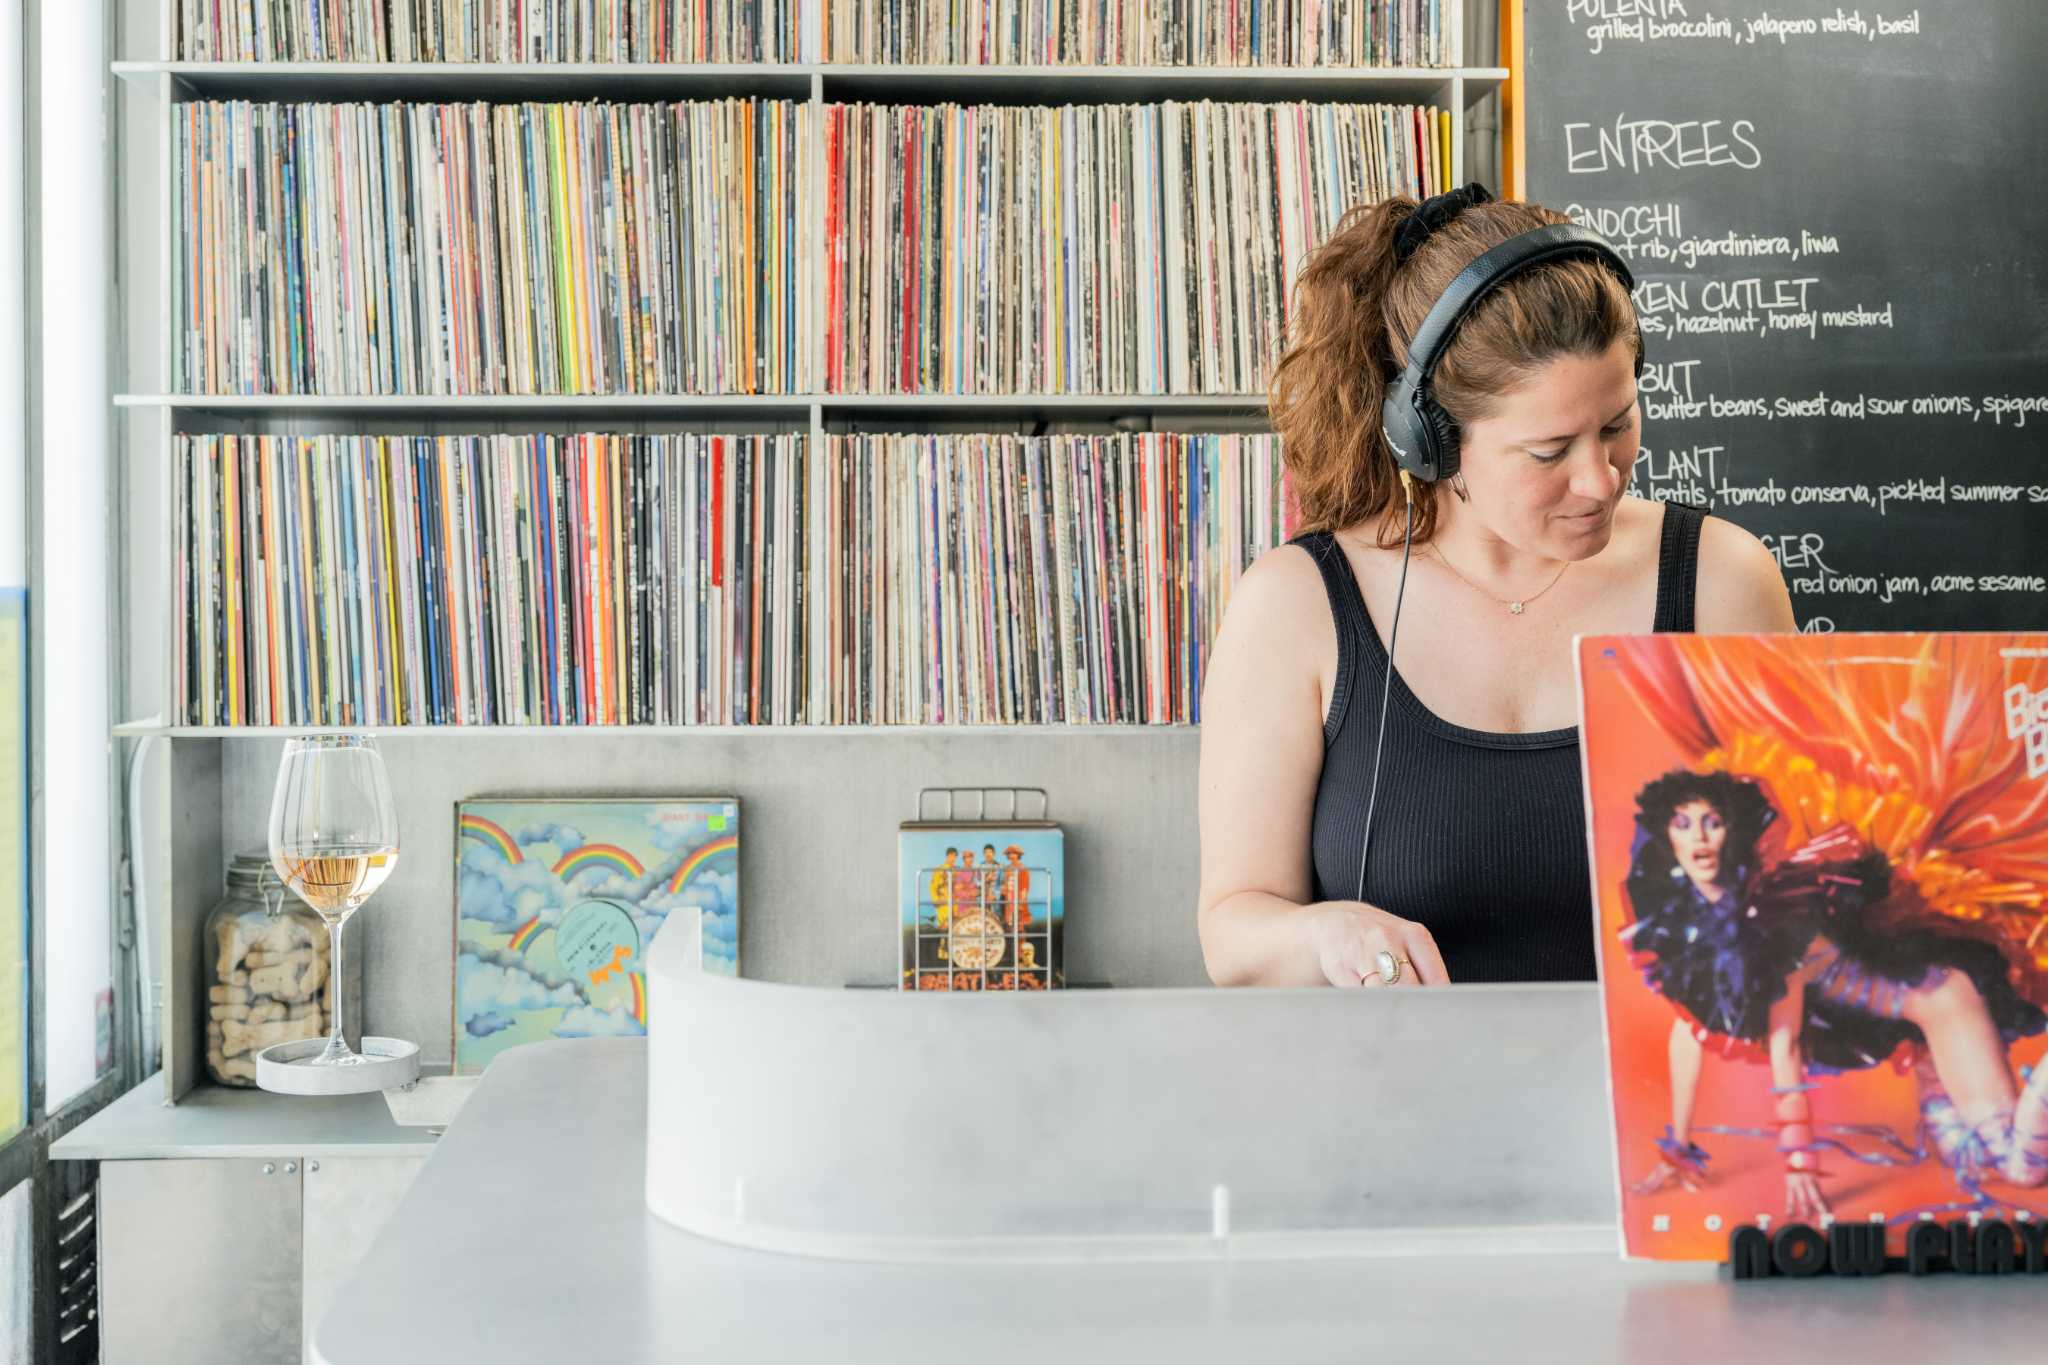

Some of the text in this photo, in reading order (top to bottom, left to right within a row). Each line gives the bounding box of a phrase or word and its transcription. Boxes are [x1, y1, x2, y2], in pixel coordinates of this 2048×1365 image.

[1586, 7, 1920, 54] grilled broccolini, jalapeno relish, basil
[1564, 112, 1761, 174] ENTREES
[1564, 203, 1682, 239] GNOCCHI
[1641, 236, 1678, 263] rib,
[1679, 230, 1799, 269] giardiniera,
[1802, 229, 1839, 256] liwa
[1631, 277, 1820, 314] KEN CUTLET
[1676, 311, 1766, 339] hazelnut,
[1768, 309, 1817, 340] honey
[1822, 302, 1894, 328] mustard
[1638, 359, 1702, 402] BUT
[1645, 394, 1708, 420] butter
[1709, 393, 1774, 421] beans,
[1831, 393, 1865, 420] and
[1867, 397, 1909, 415] sour
[1912, 393, 1981, 423] onions,
[1982, 393, 2048, 428] spigare
[1631, 446, 1725, 490] PLANT
[1716, 477, 1786, 507] tomato
[1790, 484, 1877, 508] conserva,
[1878, 476, 1945, 516] pickled
[1950, 485, 2025, 502] summer
[1760, 533, 1840, 575] GER
[1793, 570, 1826, 595] red
[1828, 574, 1878, 595] onion
[1931, 575, 1976, 593] acme
[1977, 574, 2047, 593] sesame
[1729, 1219, 2048, 1279] NOW PLAY
